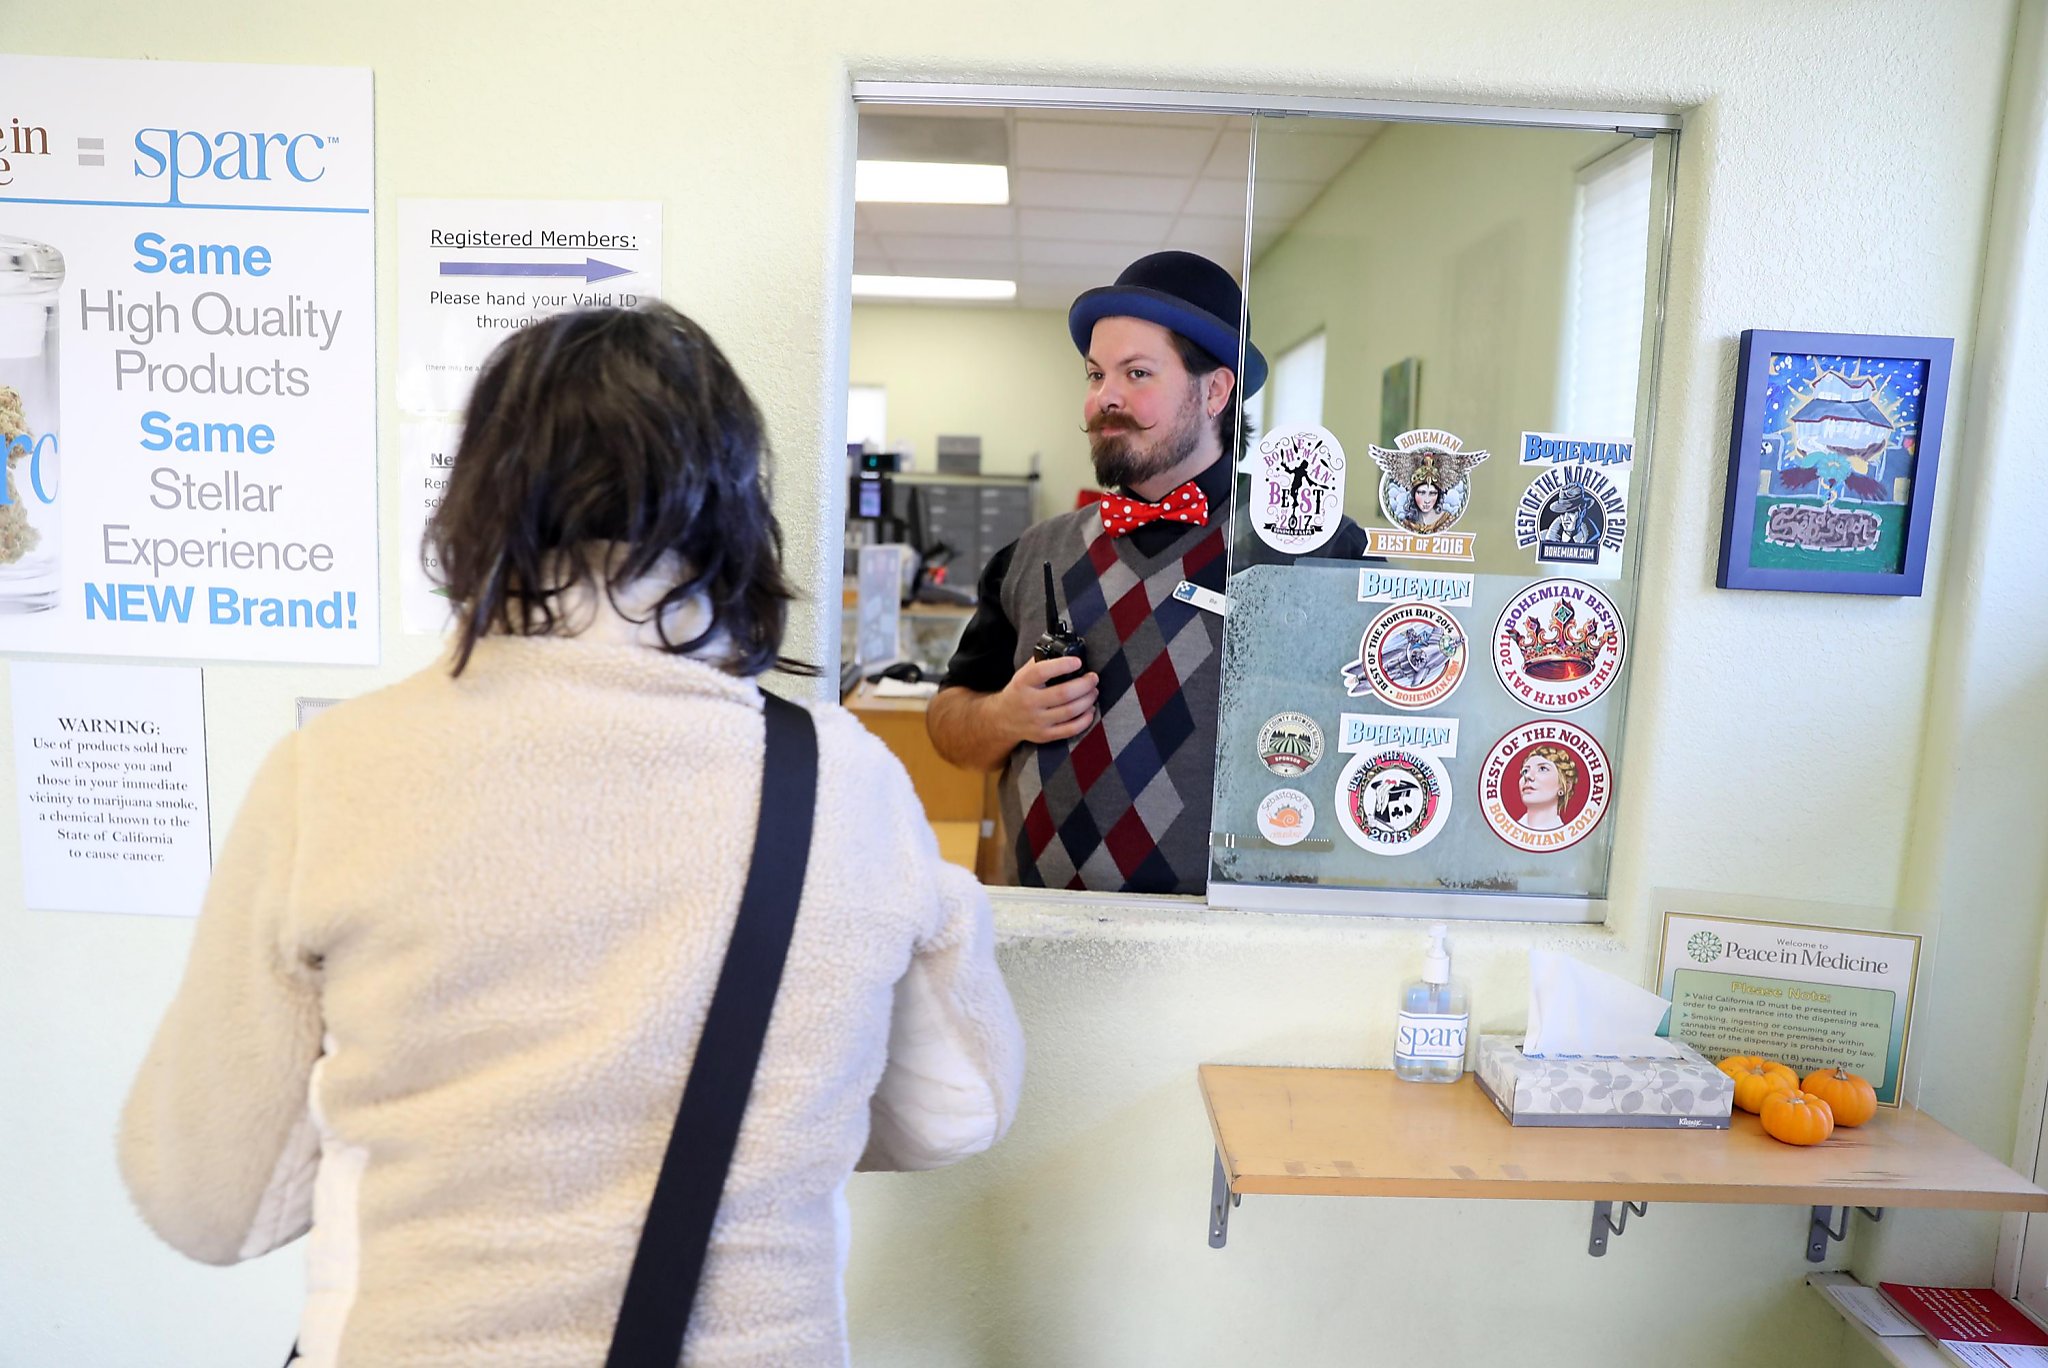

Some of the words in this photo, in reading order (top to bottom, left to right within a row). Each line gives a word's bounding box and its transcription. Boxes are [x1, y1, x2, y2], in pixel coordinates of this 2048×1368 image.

[10, 118, 51, 155] in
[134, 128, 325, 205] sparc
[431, 229, 532, 248] Registered
[541, 230, 636, 248] Members:
[133, 232, 272, 277] Same
[430, 291, 480, 305] Please
[486, 291, 525, 305] hand
[532, 294, 567, 308] your
[572, 292, 611, 306] Valid
[619, 294, 637, 307] ID
[80, 288, 179, 345] High
[191, 291, 342, 351] Quality
[115, 349, 310, 396] Products
[140, 410, 275, 454] Same
[1400, 431, 1460, 451] BOHEMIAN
[1263, 438, 1332, 484] BOHEMIAN
[1523, 434, 1633, 466] BOHEMIAN
[150, 467, 282, 512] Stellar
[1534, 469, 1562, 495] THE
[1563, 466, 1609, 493] NORTH
[1268, 481, 1325, 514] BEST
[1522, 489, 1542, 510] OF
[1600, 486, 1625, 514] BAY
[1280, 515, 1312, 531] 2017
[1517, 509, 1538, 547] BEST
[1377, 534, 1414, 551] BEST
[1432, 537, 1464, 554] 2016
[1603, 518, 1626, 553] 2015
[103, 523, 334, 578] Experience
[1543, 546, 1595, 560] BOHEMIAN.COM
[1362, 571, 1471, 602] BOHEMIAN
[84, 582, 195, 623] NEW
[208, 587, 357, 629] Brand!
[1415, 608, 1436, 620] BAY
[1504, 586, 1585, 631] BOHEMIAN
[1585, 594, 1617, 632] BEST
[1380, 608, 1413, 630] NORTH
[1435, 615, 1455, 634] 2014
[1369, 630, 1383, 650] THE
[1500, 634, 1513, 667] 2011
[1606, 632, 1618, 656] OF
[1367, 651, 1376, 665] OF
[1369, 667, 1389, 691] BEST
[1394, 660, 1461, 703] BOHEMIAN.COM
[1505, 670, 1533, 698] BAY
[1590, 659, 1615, 690] THE
[1533, 685, 1591, 706] NORTH
[58, 717, 160, 735] WARNING:
[1346, 720, 1451, 748] BOHEMIAN
[33, 737, 56, 749] Use
[60, 739, 72, 749] of
[77, 740, 130, 754] products
[133, 742, 158, 753] sold
[162, 743, 188, 754] here
[50, 756, 73, 768] will
[77, 761, 120, 773] expose
[123, 762, 146, 774] you
[149, 761, 172, 772] and
[1348, 769, 1364, 793] BEST
[1377, 750, 1400, 762] THE
[1401, 751, 1434, 780] NORTH
[1486, 756, 1505, 800] BEST
[1501, 737, 1519, 757] OF
[1522, 727, 1556, 743] THE
[1558, 729, 1602, 771] NORTH
[1590, 773, 1604, 807] BAY
[37, 774, 71, 785] those
[74, 776, 86, 787] in
[90, 778, 118, 791] your
[122, 777, 188, 791] immediate
[30, 792, 73, 807] vicinity
[77, 796, 90, 804] to
[93, 796, 152, 810] marijuana
[155, 798, 198, 811] smoke,
[39, 812, 45, 821] a
[49, 810, 104, 823] chemical
[108, 813, 149, 825] known
[153, 817, 166, 826] to
[170, 816, 190, 827] the
[1489, 802, 1565, 846] BOHEMIAN
[1567, 807, 1597, 837] 2012
[57, 829, 90, 841] State
[93, 831, 107, 841] of
[112, 831, 173, 844] California
[1369, 826, 1412, 845] 2013
[69, 849, 82, 858] to
[85, 851, 119, 860] cause
[123, 852, 165, 861] cancer.
[1776, 938, 1816, 950] Welcome
[1725, 941, 1778, 963] Peace
[1780, 948, 1797, 965] in
[1801, 949, 1889, 975] Medicine
[1692, 992, 1713, 1001] Valid
[1715, 995, 1754, 1006] California
[1768, 1002, 1789, 1010] must
[1804, 1006, 1847, 1016] presented
[1731, 981, 1783, 998] Please
[1788, 987, 1831, 1003] Note:
[1683, 1001, 1704, 1009] order
[1739, 1008, 1774, 1017] entrance
[1812, 1015, 1858, 1027] dispensing
[1731, 1017, 1769, 1029] ingesting
[1782, 1024, 1828, 1035] consuming
[1680, 1021, 1716, 1030] cannabis
[1718, 1025, 1755, 1035] medicine
[1786, 1033, 1824, 1042] premises
[1699, 1031, 1715, 1039] feet
[1744, 1036, 1789, 1048] dispensary
[1800, 1043, 1844, 1053] prohibited
[1687, 1042, 1707, 1051] Only
[1708, 1046, 1741, 1054] persons
[1743, 1049, 1779, 1059] eighteen
